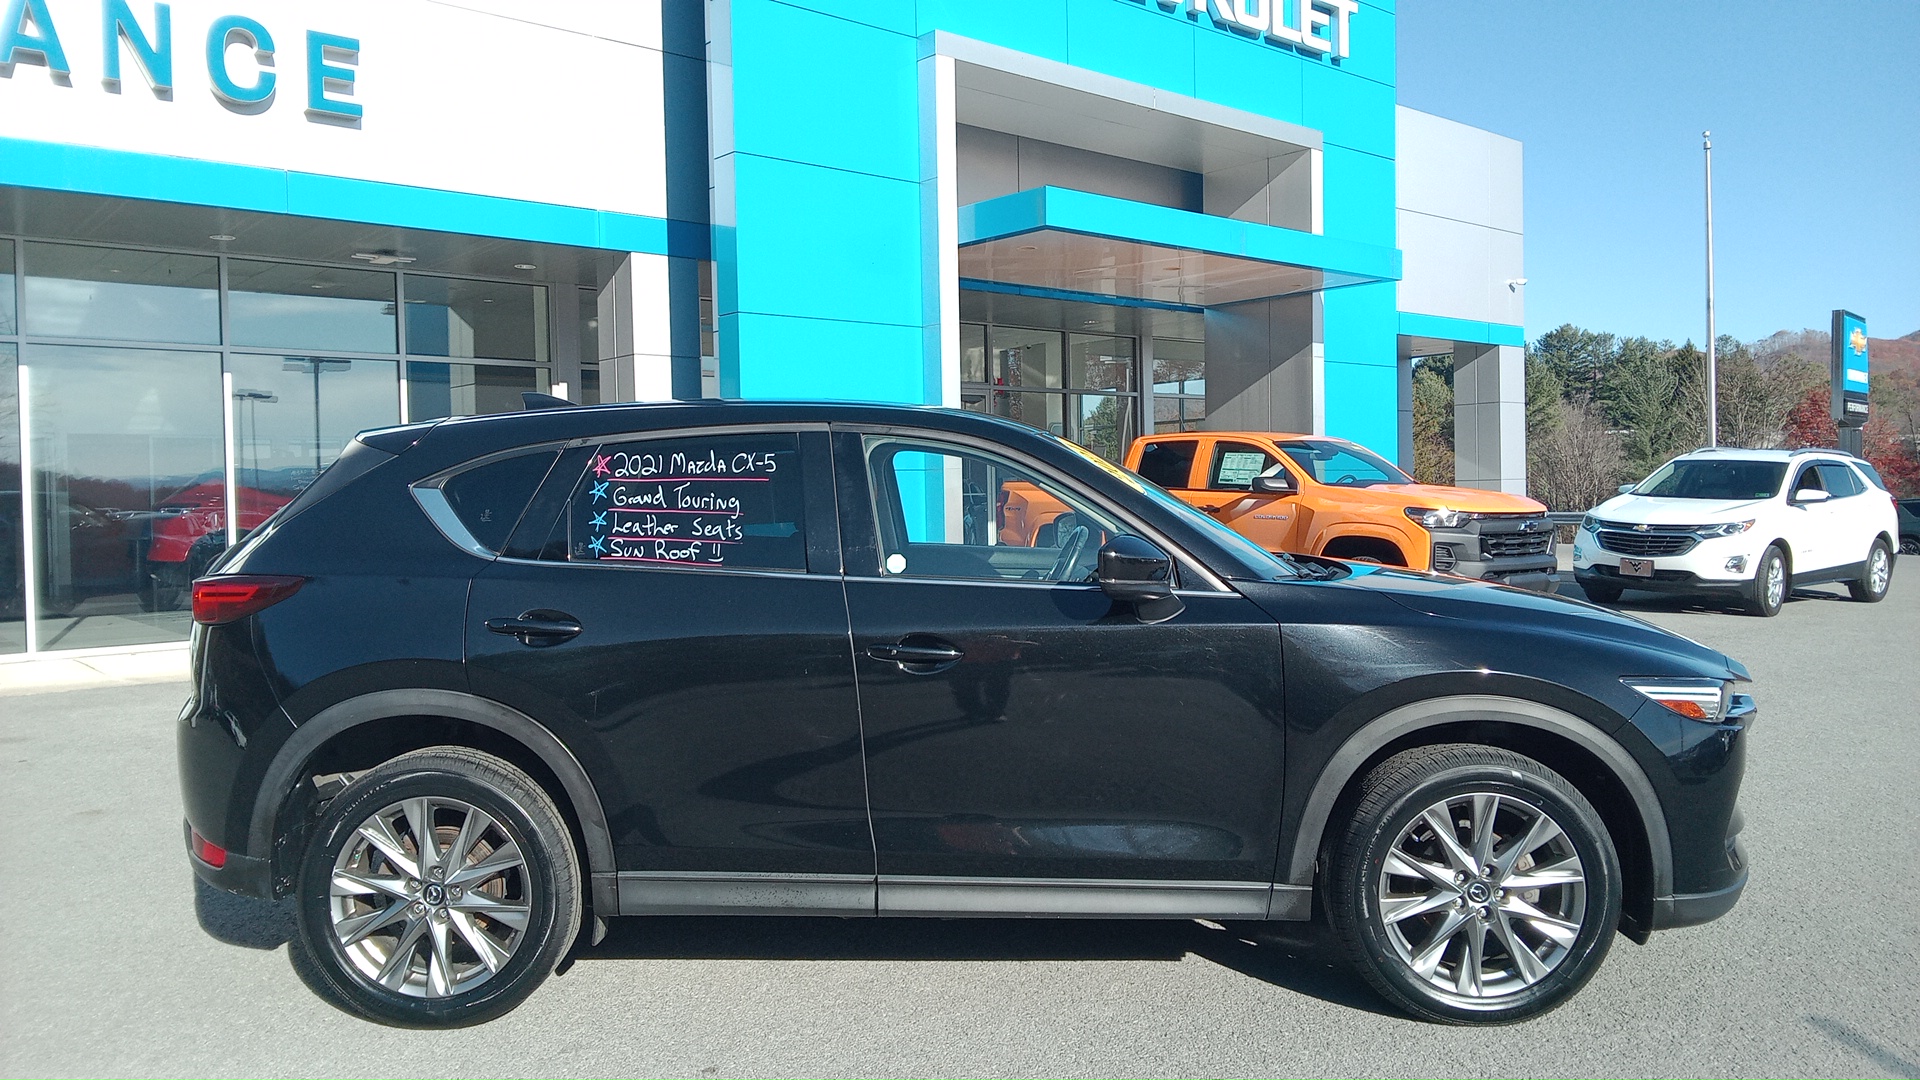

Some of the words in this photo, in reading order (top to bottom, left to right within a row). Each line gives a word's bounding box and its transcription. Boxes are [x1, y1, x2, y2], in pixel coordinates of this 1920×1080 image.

[613, 452, 663, 478] 2021
[731, 452, 777, 474] CX-5
[612, 485, 668, 508] Grand
[673, 482, 741, 519] Touring
[612, 512, 679, 535] Leather
[691, 520, 743, 540] Seats
[654, 540, 701, 561] Roof
